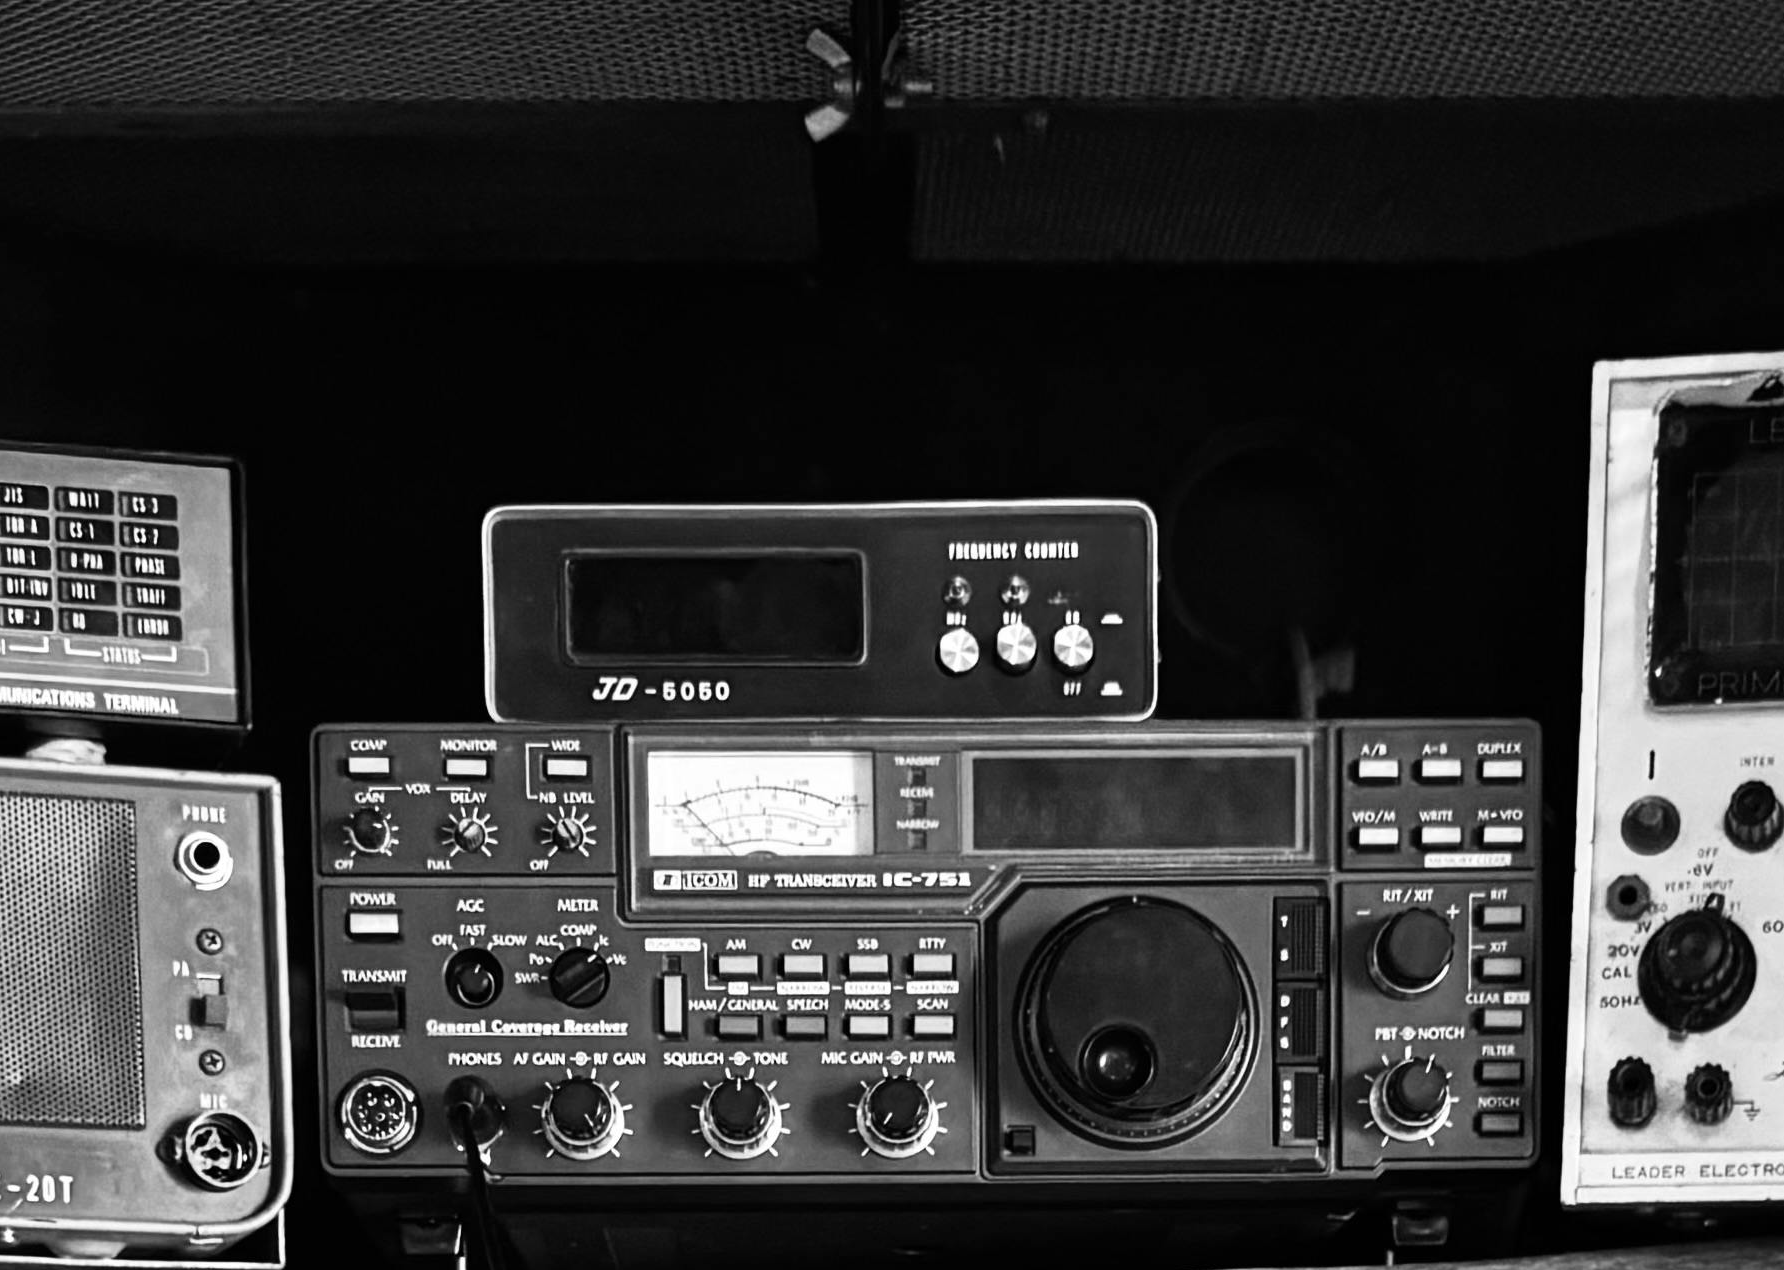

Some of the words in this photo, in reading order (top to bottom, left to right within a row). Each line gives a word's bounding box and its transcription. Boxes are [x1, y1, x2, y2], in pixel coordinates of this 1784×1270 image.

[103, 693, 179, 714] TERMINAL
[441, 740, 497, 751] MONITOR
[1478, 743, 1520, 754] DUPLEX
[183, 805, 226, 823] PHONE
[749, 875, 770, 887] HF
[774, 874, 877, 887] TRANSCEIVER
[342, 970, 407, 982] TRANSMIT
[787, 999, 828, 1010] SPEECH
[426, 1020, 490, 1035] General
[486, 1020, 565, 1036] Coverage
[559, 1019, 628, 1035] Receiver
[1418, 1027, 1464, 1039] NOTCH
[352, 1035, 401, 1047] RECEIVE
[449, 1053, 502, 1065] PHONES
[664, 1052, 724, 1067] SQUELCH
[1612, 1165, 1685, 1179] LEADER
